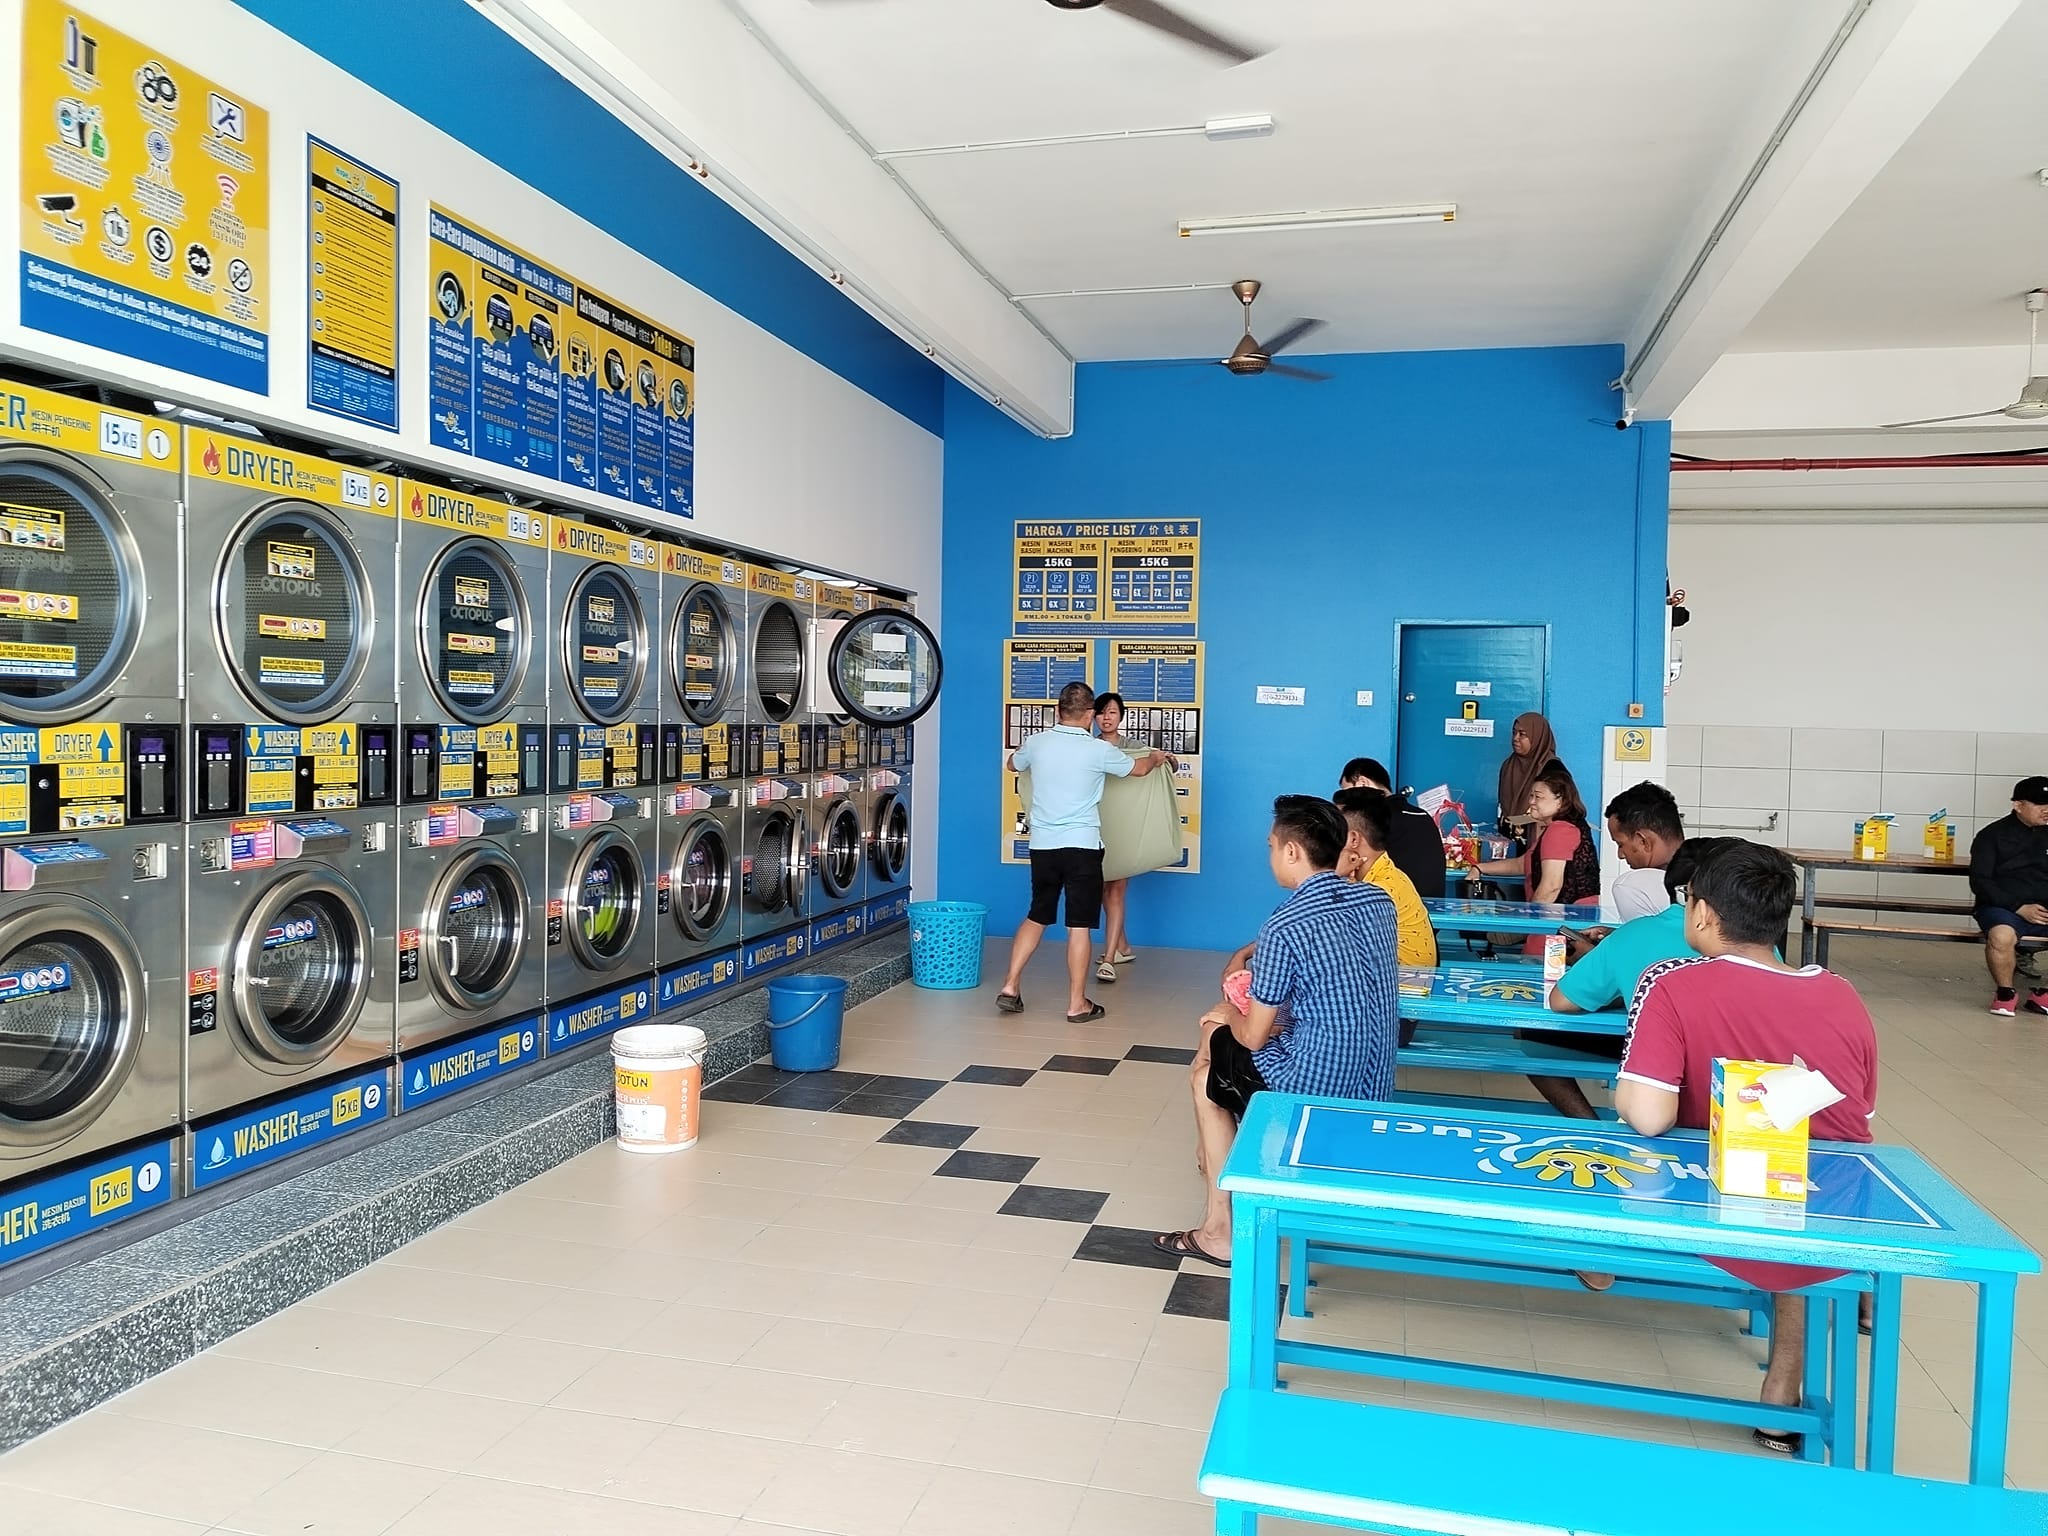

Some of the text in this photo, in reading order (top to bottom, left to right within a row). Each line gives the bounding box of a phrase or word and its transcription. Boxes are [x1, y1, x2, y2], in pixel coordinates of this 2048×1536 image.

[431, 213, 461, 246] Cara-Cara
[462, 232, 498, 265] penggunaan
[498, 251, 515, 274] mesin
[482, 342, 494, 360] Sila
[494, 348, 506, 364] pilih
[482, 360, 499, 378] tekan
[512, 372, 520, 384] air
[526, 361, 538, 377] Sila
[539, 367, 552, 382] pilih
[526, 378, 544, 394] tekan
[31, 410, 52, 422] MESIN
[54, 414, 92, 432] PENGERING
[155, 435, 161, 454] 1
[462, 438, 470, 450] 1
[522, 456, 529, 468] 2
[227, 446, 294, 488] DRYER
[378, 488, 386, 502] 2
[588, 476, 596, 487] 3
[428, 493, 474, 526] DRYER
[534, 524, 540, 536] 3
[1025, 525, 1063, 536] HARGA
[1066, 525, 1072, 536] /
[1076, 524, 1110, 536] PRICE
[1112, 524, 1136, 536] LIST
[1139, 524, 1146, 536] /
[570, 528, 605, 555] DRYER
[648, 550, 654, 562] 4
[676, 552, 703, 576] DRYER
[736, 568, 742, 581] 5
[1044, 558, 1072, 567] 15KG
[1140, 557, 1169, 566] 15KG
[758, 572, 780, 594] DRYER
[1027, 574, 1035, 582] P1
[1054, 574, 1062, 582] P2
[1080, 574, 1090, 582] P3
[261, 576, 322, 598] OCTOPUS
[1112, 588, 1120, 597] 5X
[1134, 588, 1142, 597] 6X
[1154, 588, 1162, 597] 7X
[1174, 588, 1183, 597] 8X
[824, 588, 842, 604] DRYER
[1022, 600, 1032, 608] 5X
[1048, 600, 1058, 608] 6X
[1075, 600, 1084, 608] 7X
[450, 605, 494, 622] OCTOPUS
[585, 622, 618, 637] OCTOPUS
[264, 730, 336, 748] WASHER DRYER
[451, 730, 502, 745] WASHER DRYER
[586, 729, 626, 741] WASHER DRYER
[55, 734, 92, 753] DRYER
[96, 766, 112, 776] Token
[820, 922, 838, 942] WASHER
[754, 944, 776, 966] WASHER
[674, 970, 700, 996] WASHER
[728, 962, 733, 974] 5
[569, 1004, 603, 1036] WASHER
[639, 994, 645, 1006] 4
[430, 1049, 476, 1088] WASHER
[524, 1034, 531, 1048] 3
[234, 1110, 298, 1159] WASHER
[368, 1088, 376, 1104] 2
[1371, 1119, 1522, 1144] Cuci
[42, 1204, 62, 1218] MESIN
[64, 1194, 86, 1211] BASUH
[146, 1168, 151, 1185] 1
